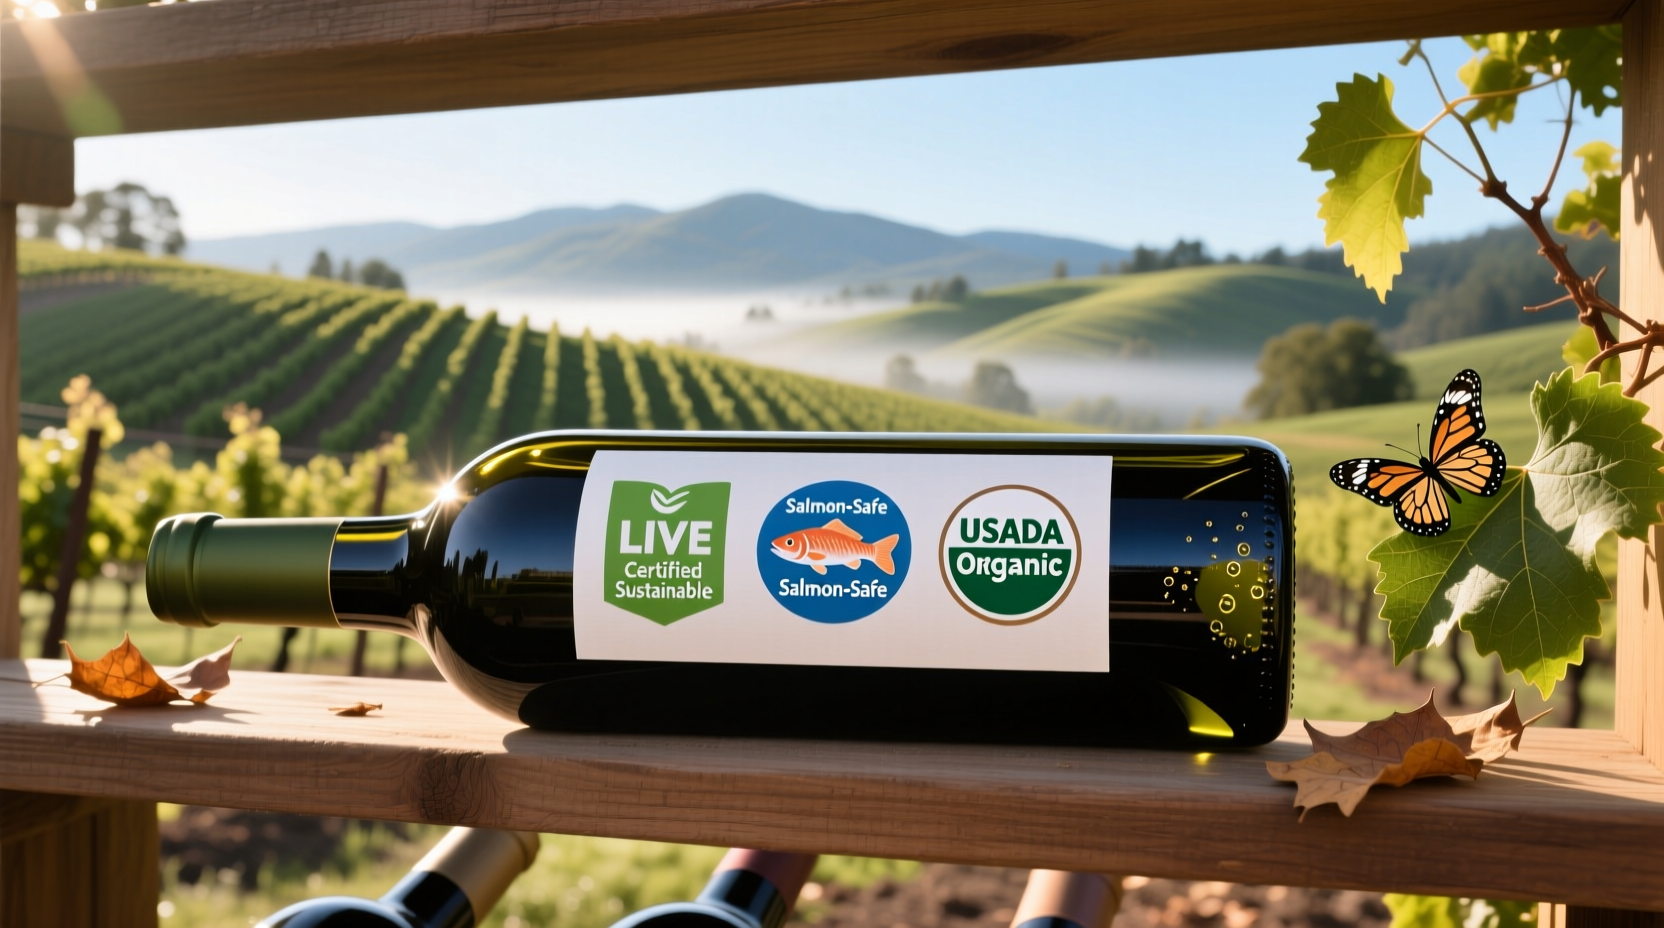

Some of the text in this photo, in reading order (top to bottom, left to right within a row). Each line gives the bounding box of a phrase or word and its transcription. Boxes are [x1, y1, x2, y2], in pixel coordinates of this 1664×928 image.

[785, 496, 888, 514] Salmon-Safe
[620, 520, 713, 555] LIVE
[960, 517, 1065, 544] USADA
[624, 561, 702, 579] Certified
[956, 552, 1063, 583] Organic
[615, 580, 713, 600] Sustainable
[778, 578, 888, 598] Salmon-Safe
